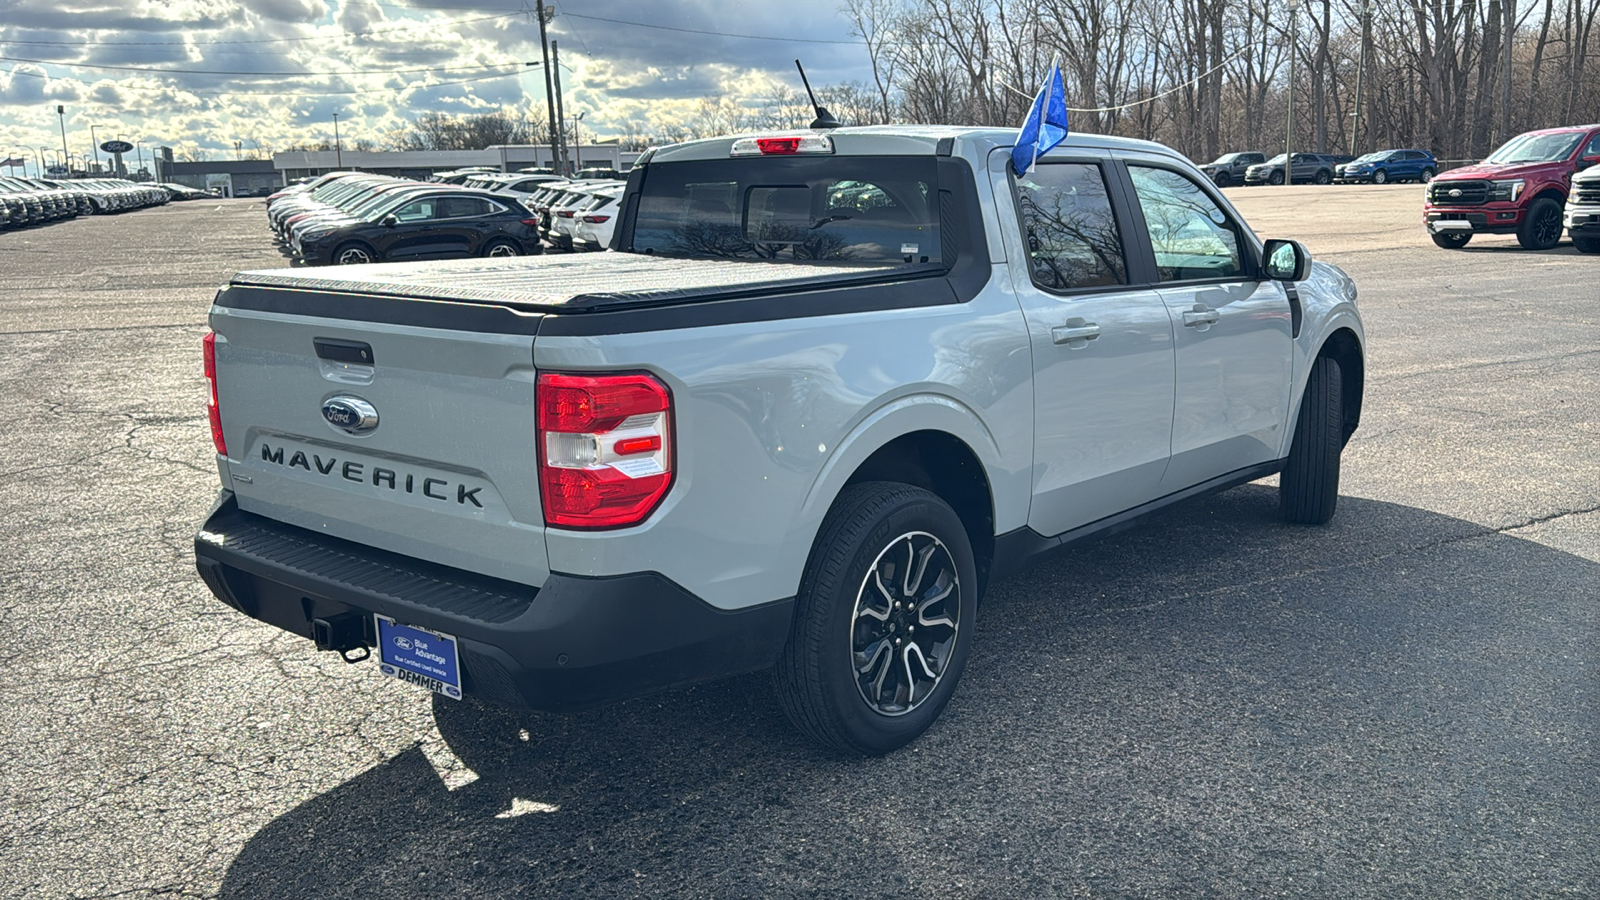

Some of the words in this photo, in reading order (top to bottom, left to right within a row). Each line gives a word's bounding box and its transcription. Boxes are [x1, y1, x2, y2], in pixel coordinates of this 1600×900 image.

[107, 142, 126, 151] Ford
[328, 404, 350, 423] Ford
[261, 443, 484, 508] MAVERICK
[397, 637, 410, 649] Ford
[414, 639, 428, 650] Blue
[404, 658, 421, 668] Certified
[415, 648, 446, 665] Advantage
[398, 668, 443, 693] DEMMER
